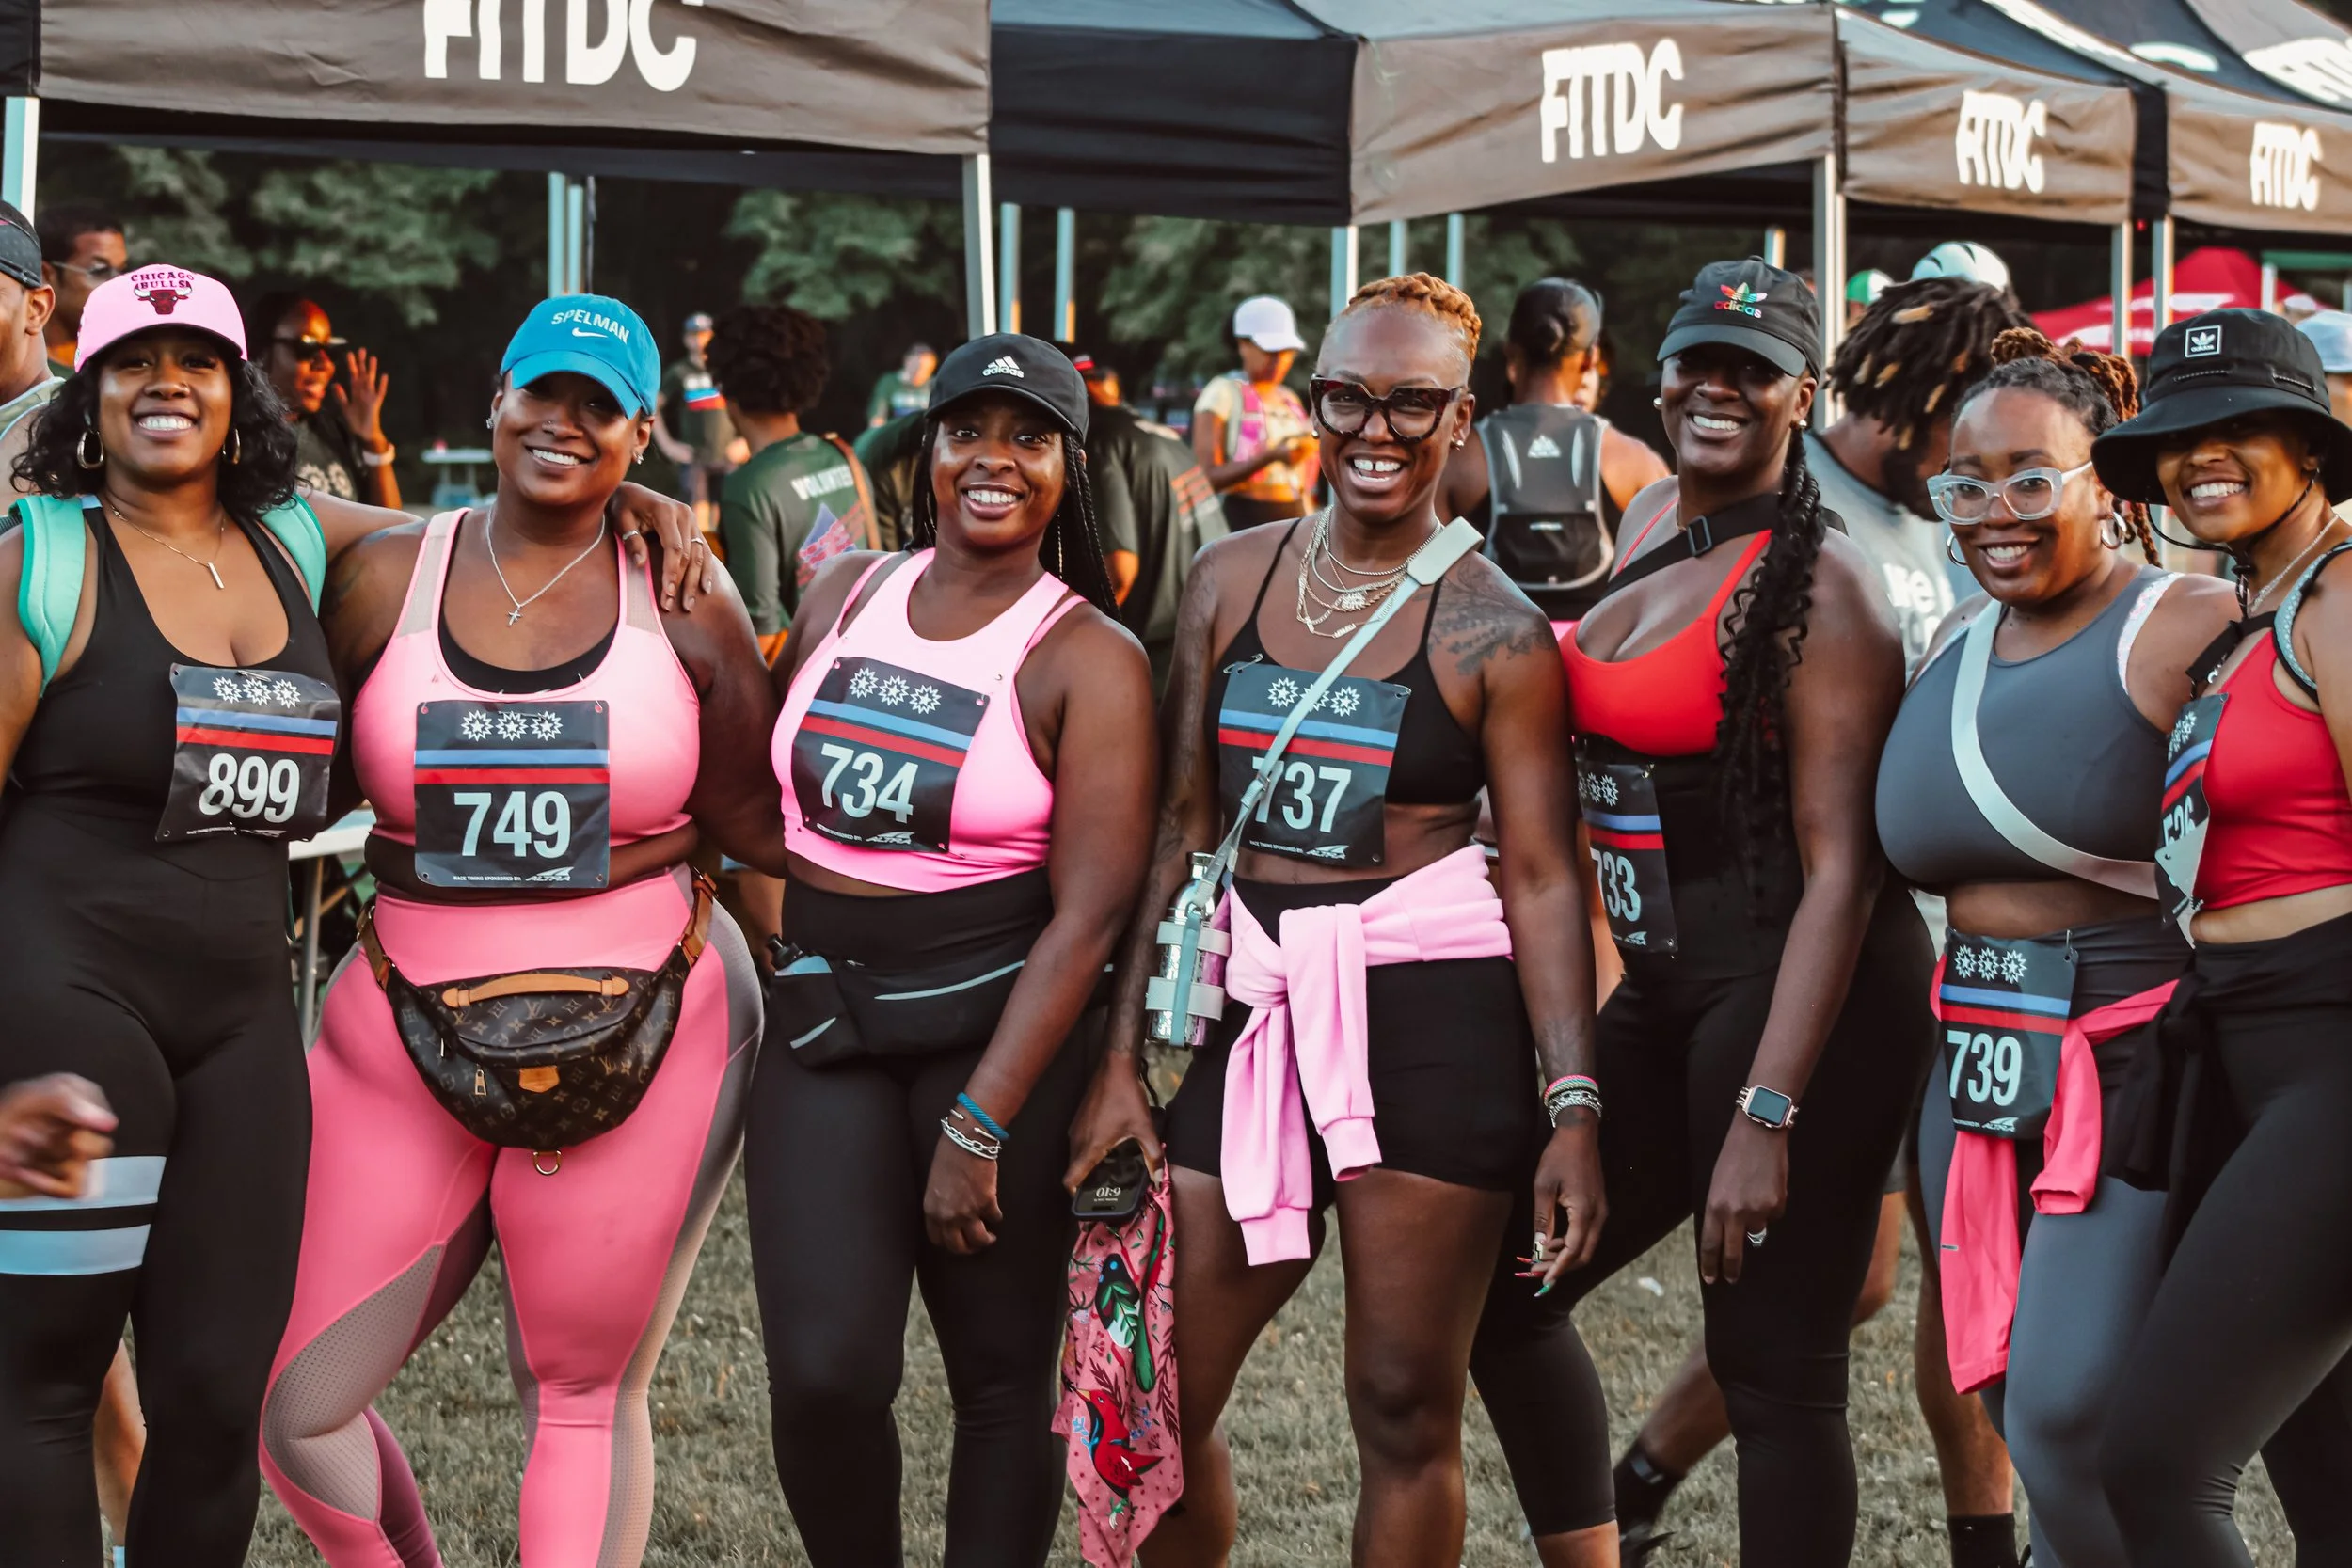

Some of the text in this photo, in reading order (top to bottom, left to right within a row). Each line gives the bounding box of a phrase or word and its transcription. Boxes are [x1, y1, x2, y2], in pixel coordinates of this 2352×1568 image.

[1540, 38, 1684, 163] FITDC
[1956, 88, 2047, 194] FITDC
[2250, 122, 2323, 211] FITDC
[131, 271, 195, 282] CHICAGO
[140, 280, 185, 289] BULLS
[1714, 300, 1762, 319] adidas
[551, 309, 629, 345] SPELMAN
[982, 364, 1025, 379] adidas
[199, 753, 300, 823] 899
[821, 743, 918, 824] 734
[1252, 756, 1352, 833] 737
[454, 791, 571, 859] 749
[525, 873, 572, 882] ALTRA
[1947, 1029, 2023, 1107] 739
[1096, 1187, 1121, 1197] 6:10
